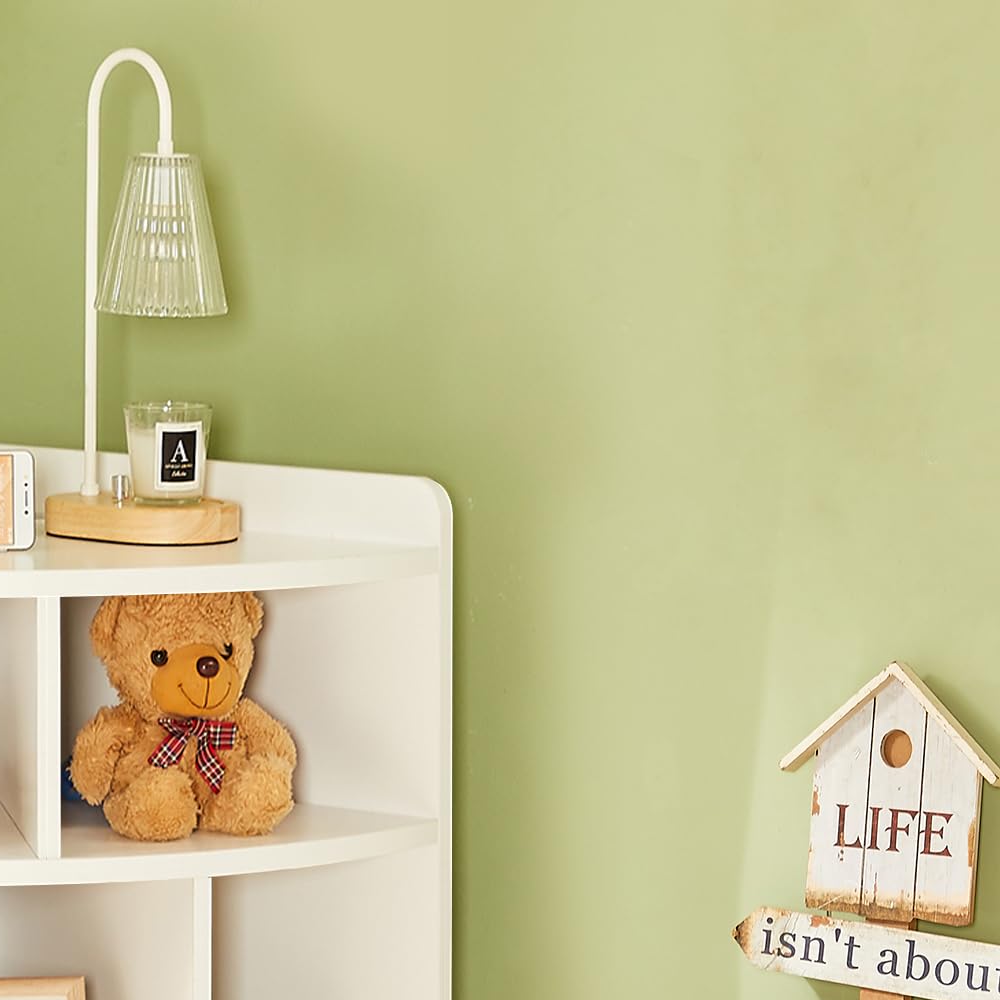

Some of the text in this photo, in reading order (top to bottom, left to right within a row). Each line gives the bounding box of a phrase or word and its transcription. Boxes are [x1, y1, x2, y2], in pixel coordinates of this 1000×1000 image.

[170, 439, 189, 463] A
[833, 803, 954, 858] LIFE
[760, 917, 861, 971] isn't
